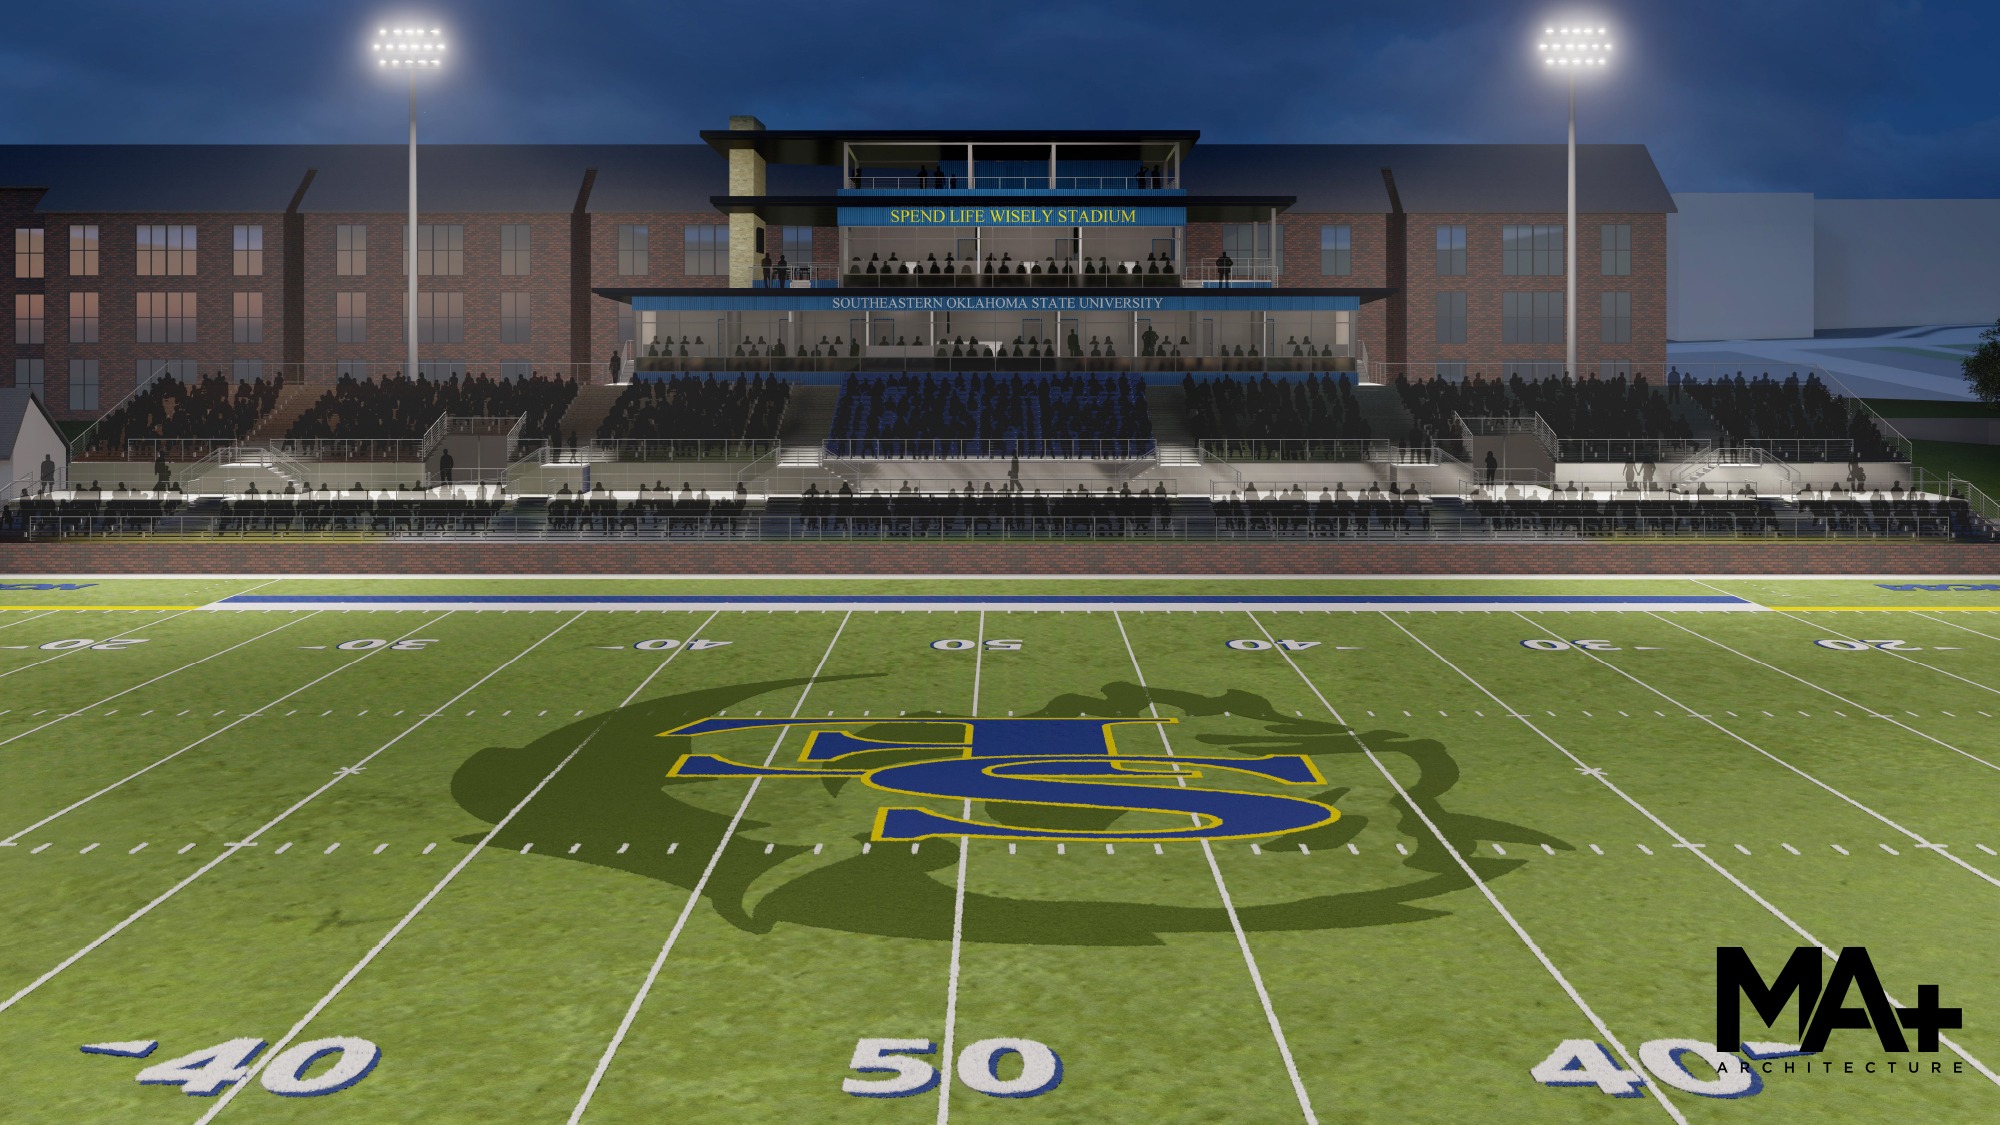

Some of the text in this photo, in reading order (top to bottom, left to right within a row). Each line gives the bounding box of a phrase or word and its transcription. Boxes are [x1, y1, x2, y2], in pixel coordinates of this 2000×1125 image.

[890, 209, 1136, 223] SPEND LIFE WISELY STADIUM
[832, 297, 1164, 309] SOUTHEASTERN OKLAHOMA STATE UNIVERSITY
[39, 638, 150, 650] 20
[336, 639, 439, 650] 30
[633, 639, 733, 650] 40
[929, 639, 1024, 650] 50
[1225, 639, 1321, 650] 40
[1519, 639, 1622, 650] 30
[1813, 639, 1922, 651] 20
[135, 1036, 382, 1098] 40
[841, 1037, 1064, 1099] 50
[1530, 1038, 1764, 1099] 40
